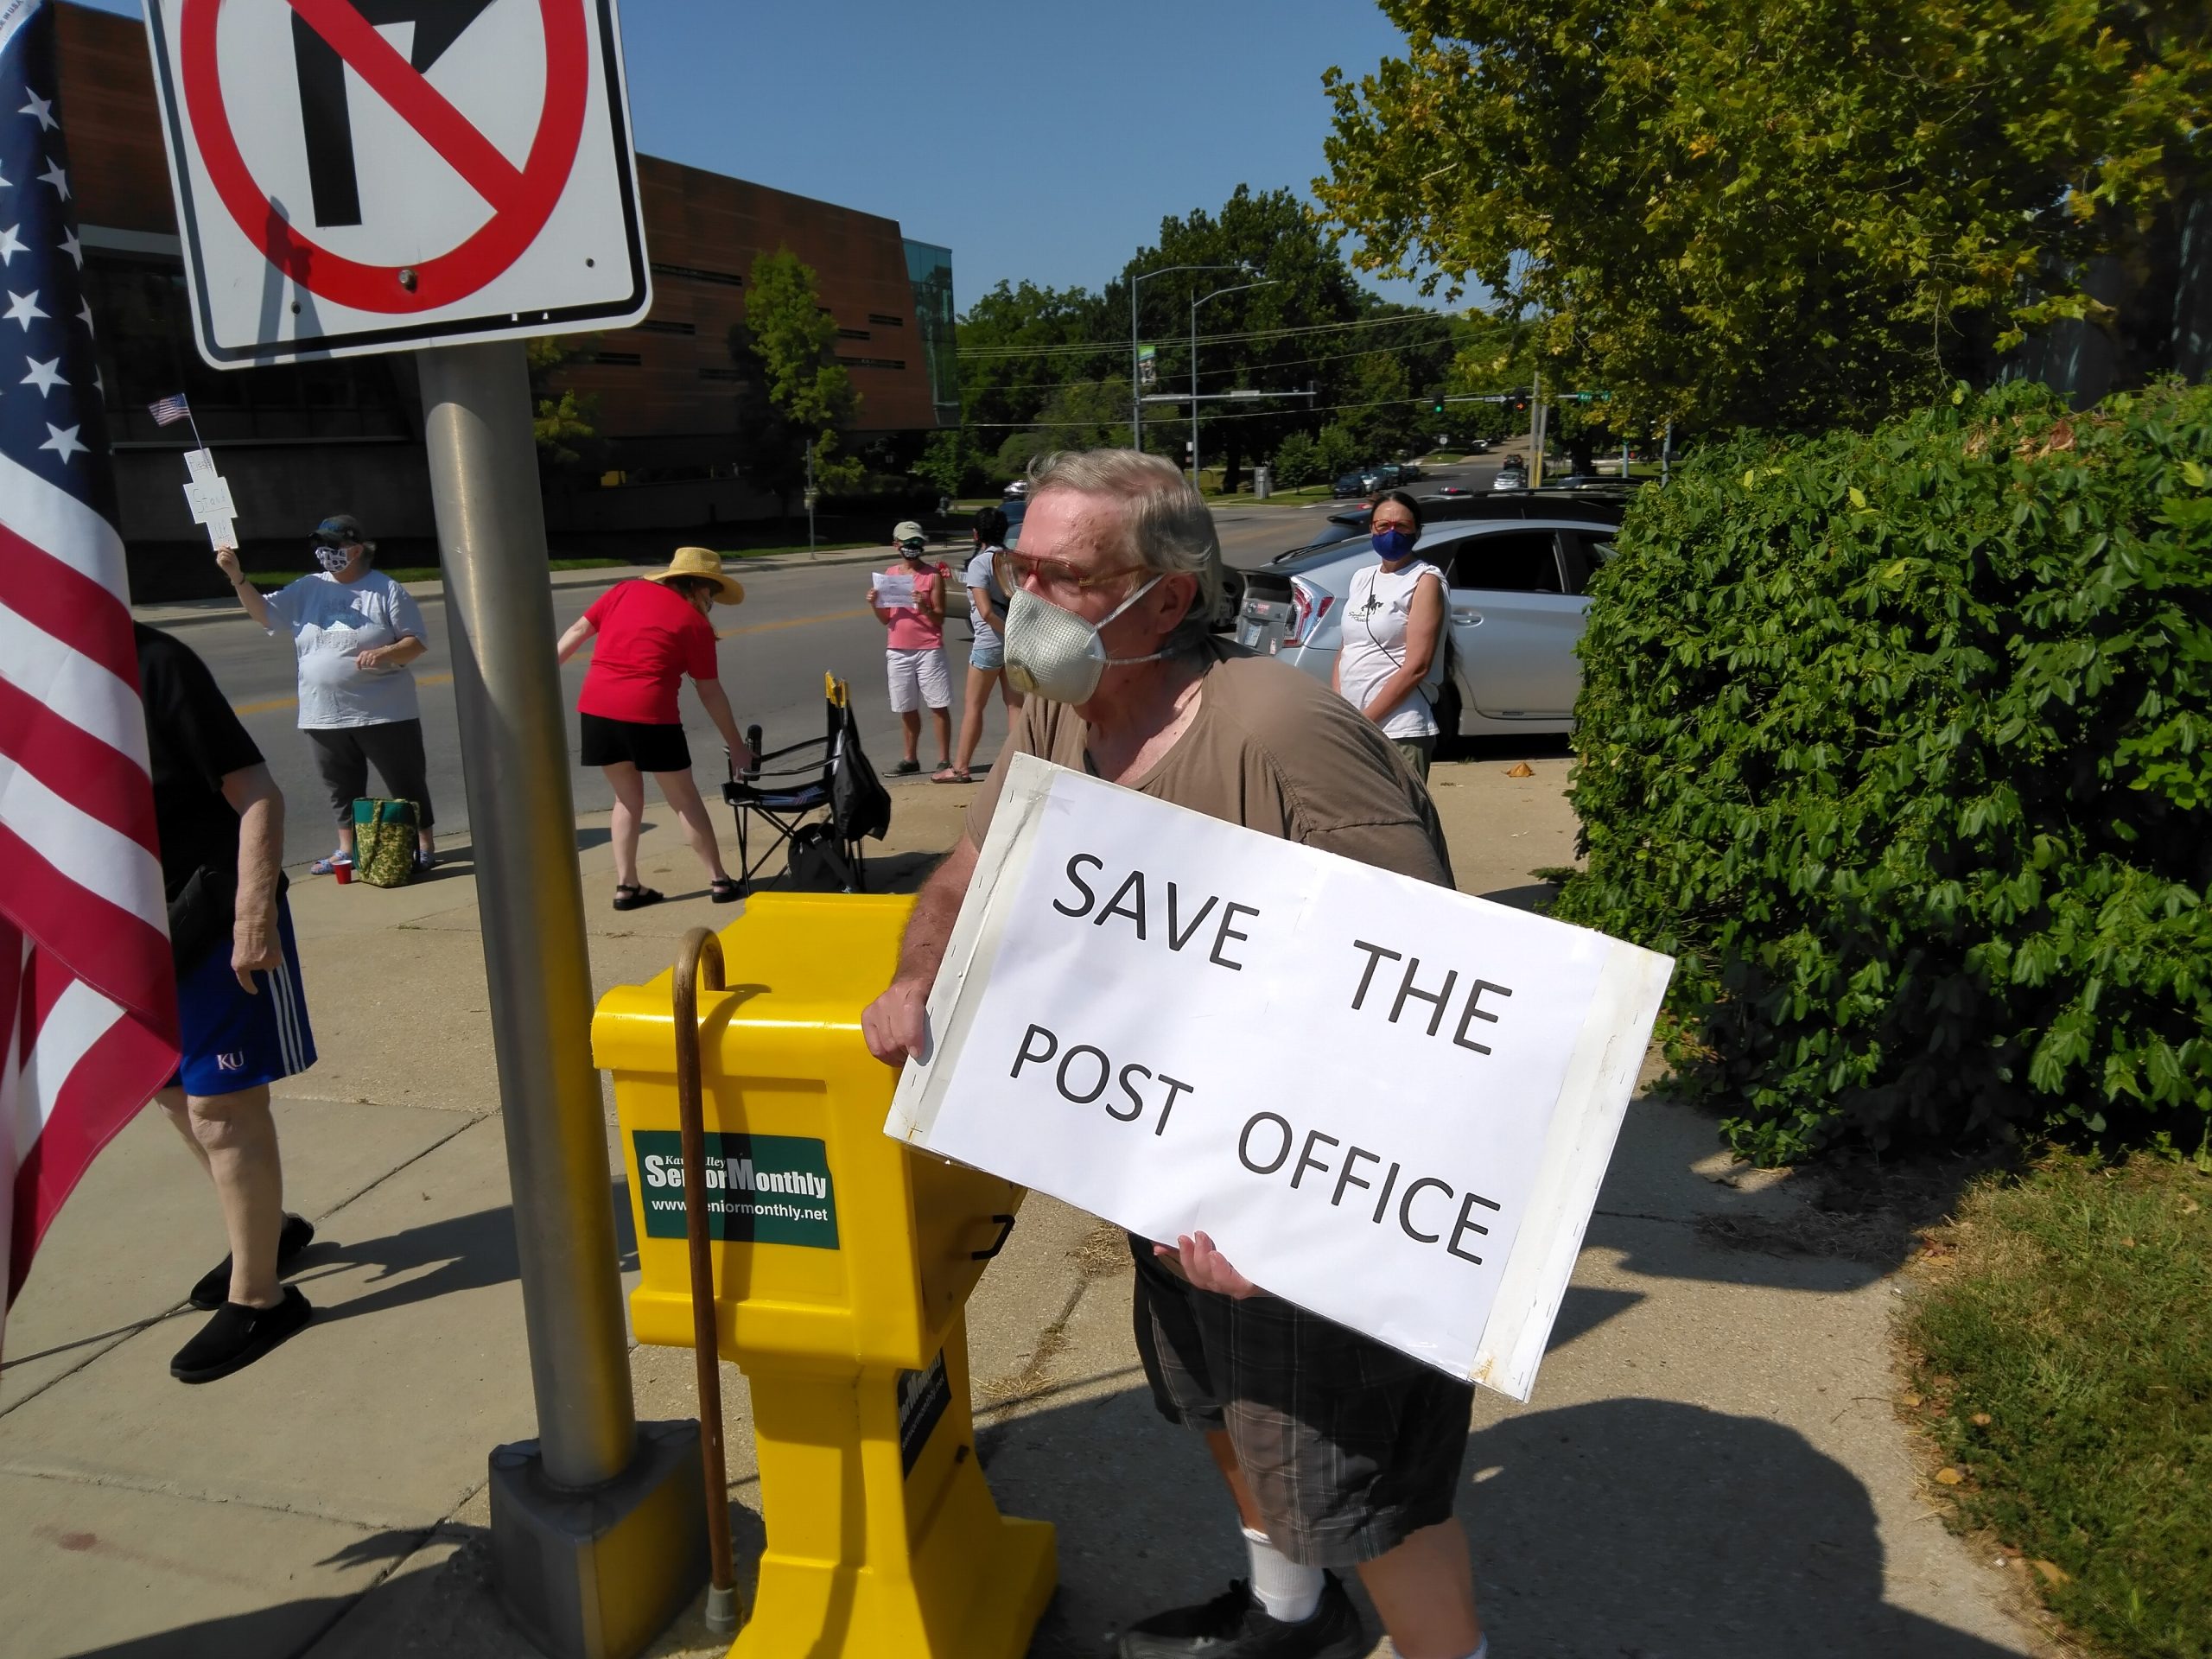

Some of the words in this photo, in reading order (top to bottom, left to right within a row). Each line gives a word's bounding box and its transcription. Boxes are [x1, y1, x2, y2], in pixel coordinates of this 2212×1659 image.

[1052, 853, 1260, 971] SAVE
[1351, 939, 1512, 1056] THE
[216, 1051, 245, 1071] KU
[1009, 1023, 1194, 1136] POST
[1237, 1111, 1500, 1265] OFFICE
